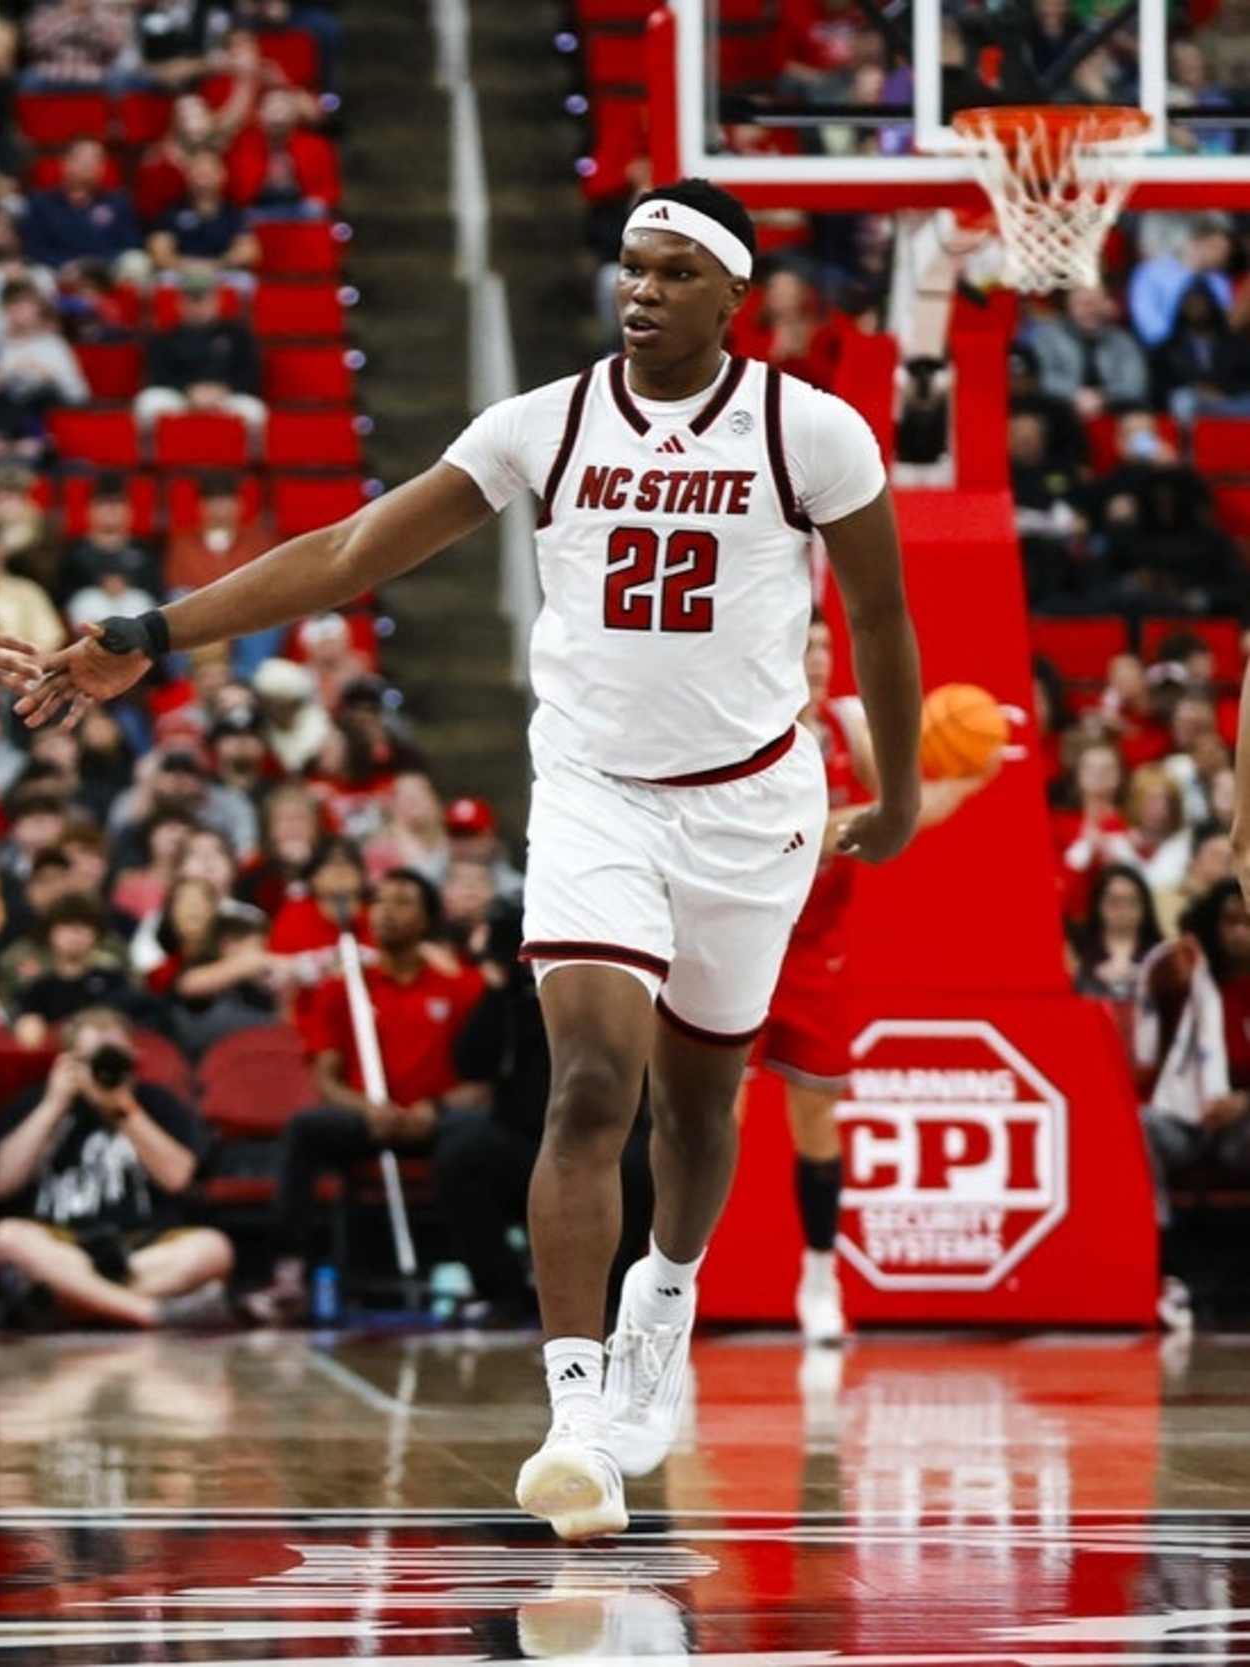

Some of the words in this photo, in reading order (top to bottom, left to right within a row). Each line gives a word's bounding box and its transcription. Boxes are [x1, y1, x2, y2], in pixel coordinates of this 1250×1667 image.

[576, 465, 634, 510] NC
[635, 470, 757, 515] STATE
[603, 526, 719, 633] 22
[851, 1068, 1017, 1101] WARNING
[838, 1117, 1042, 1191] CPI
[860, 1204, 1006, 1232] SECURITY
[865, 1231, 1004, 1265] SYSTEMS
